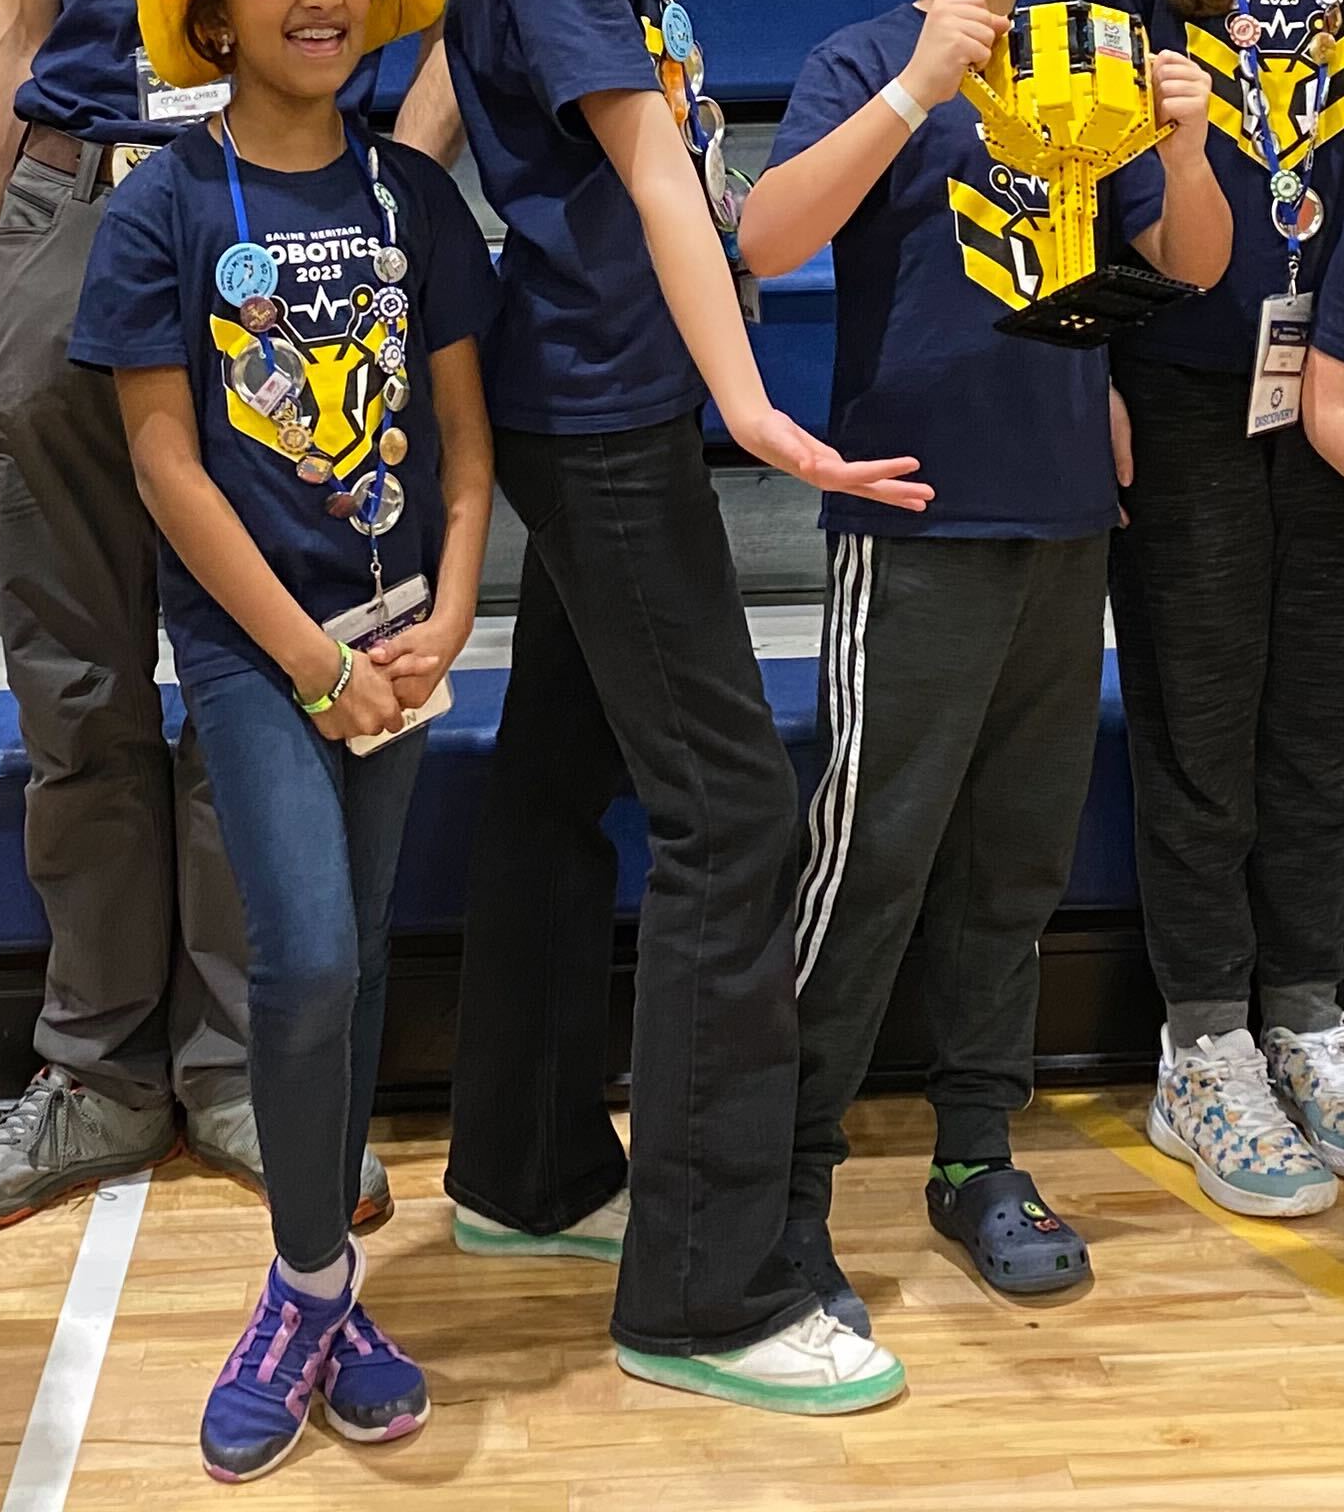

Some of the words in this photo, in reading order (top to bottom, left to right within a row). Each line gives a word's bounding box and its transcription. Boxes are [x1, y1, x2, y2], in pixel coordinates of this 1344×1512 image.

[160, 94, 192, 105] COACH
[193, 91, 218, 101] CHRIS
[265, 231, 306, 243] SALINE
[310, 226, 362, 240] HERITAGE
[265, 237, 381, 266] OBOTICS
[296, 264, 343, 283] 2023
